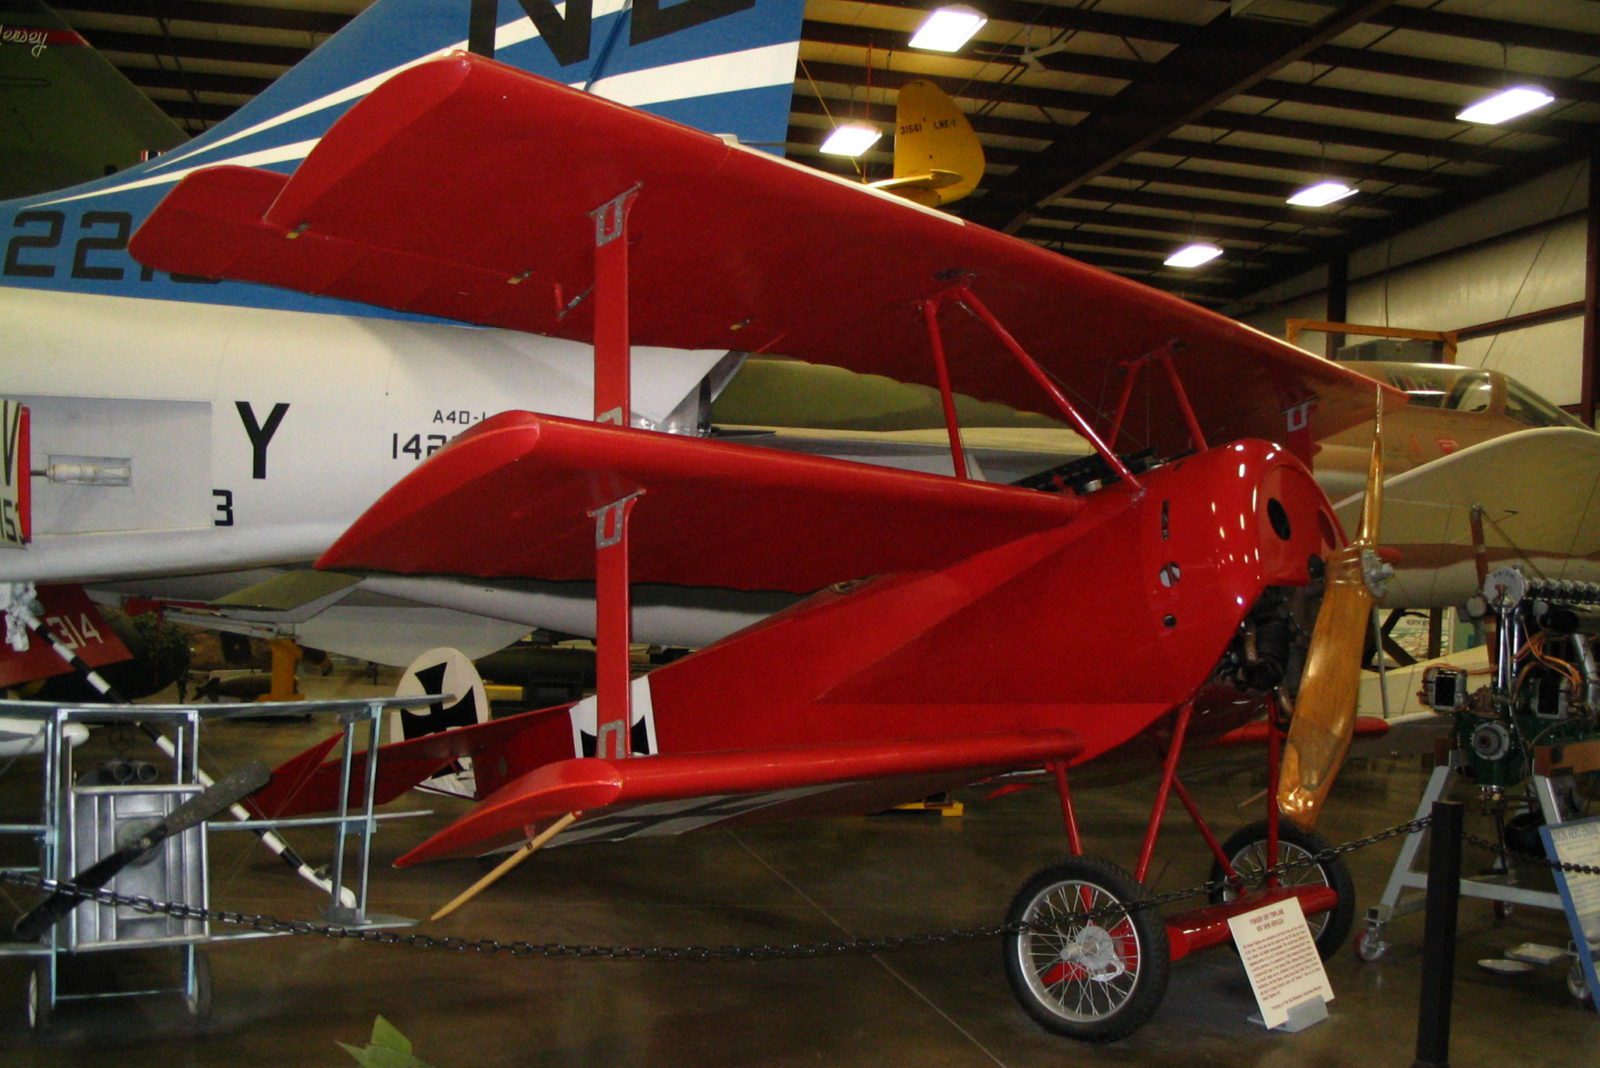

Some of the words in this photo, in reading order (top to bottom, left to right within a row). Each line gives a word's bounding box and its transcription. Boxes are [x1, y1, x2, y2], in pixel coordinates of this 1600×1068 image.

[235, 400, 291, 480] Y
[392, 432, 458, 460] 142
[212, 489, 234, 526] 3
